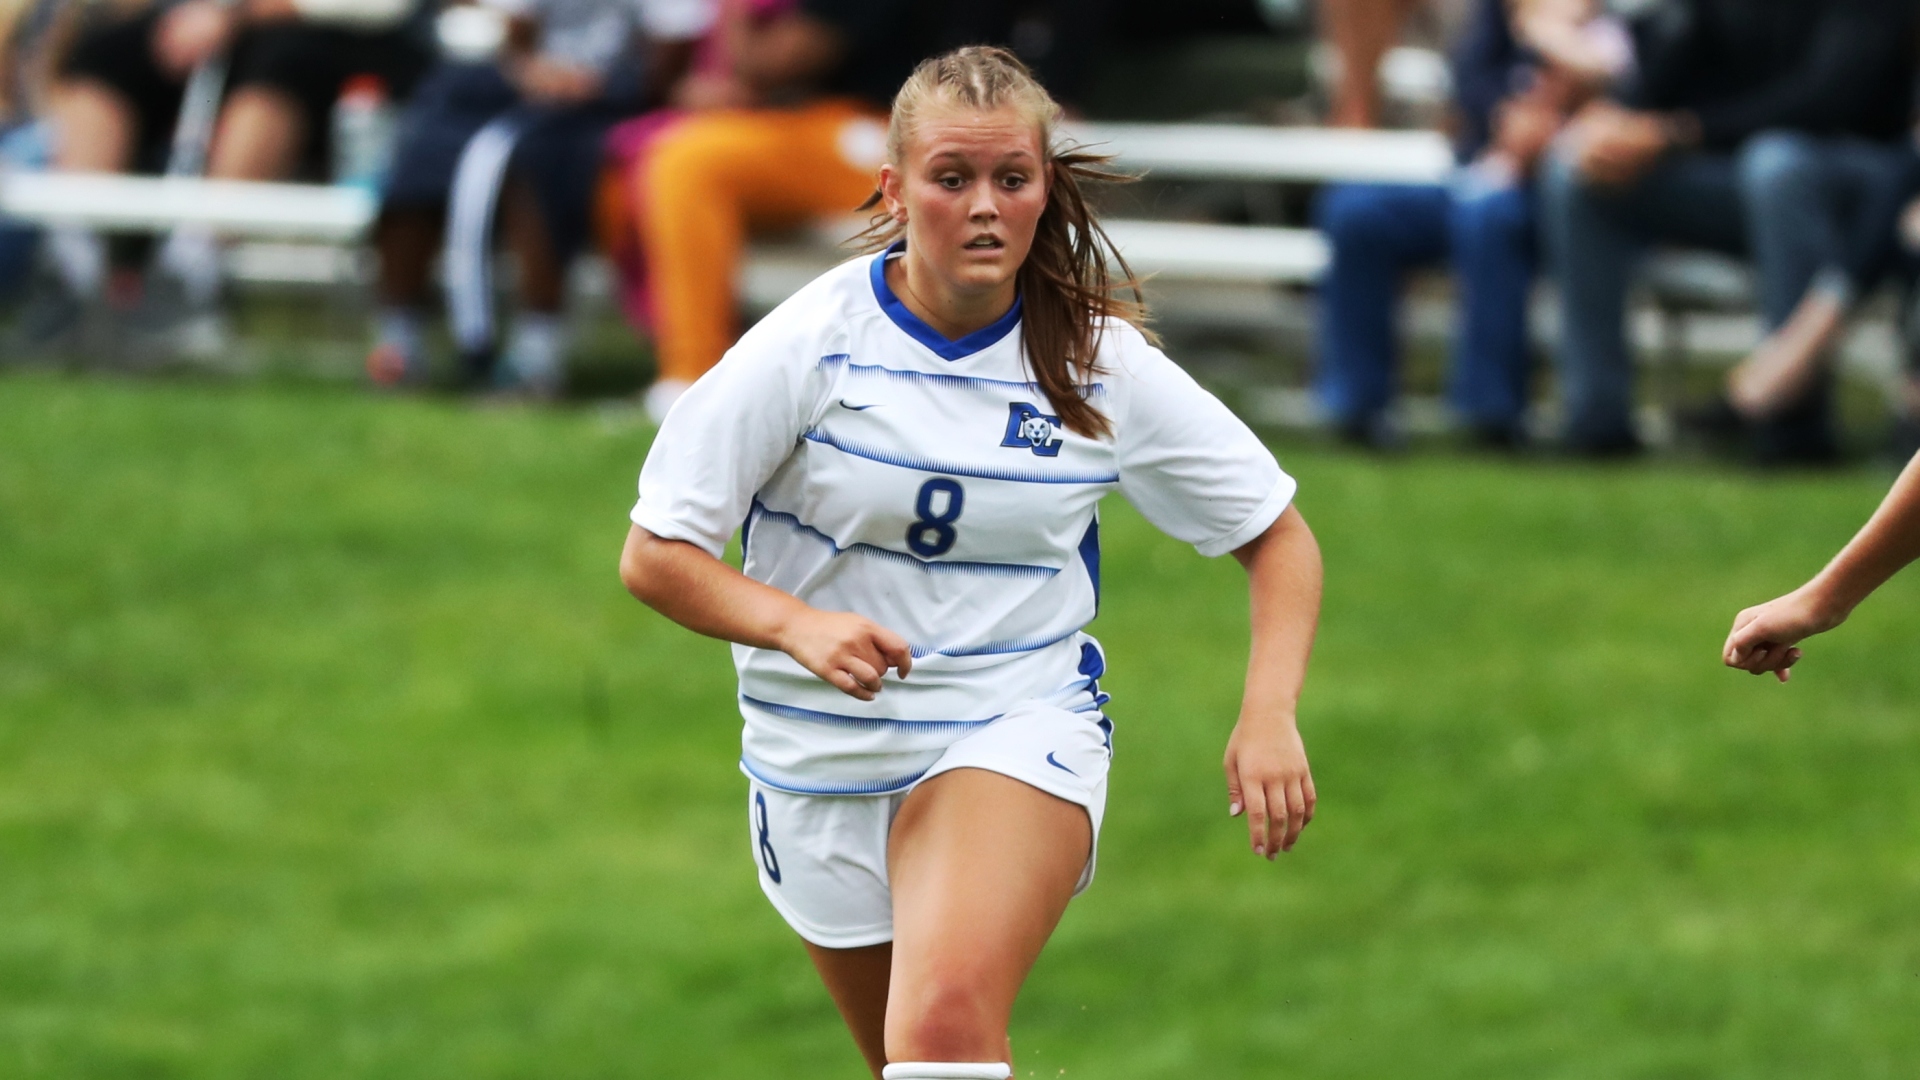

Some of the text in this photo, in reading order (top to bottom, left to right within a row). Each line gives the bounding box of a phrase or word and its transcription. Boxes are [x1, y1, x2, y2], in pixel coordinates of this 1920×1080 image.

[1000, 402, 1063, 457] DC
[905, 476, 966, 559] 8
[756, 790, 781, 885] 8
